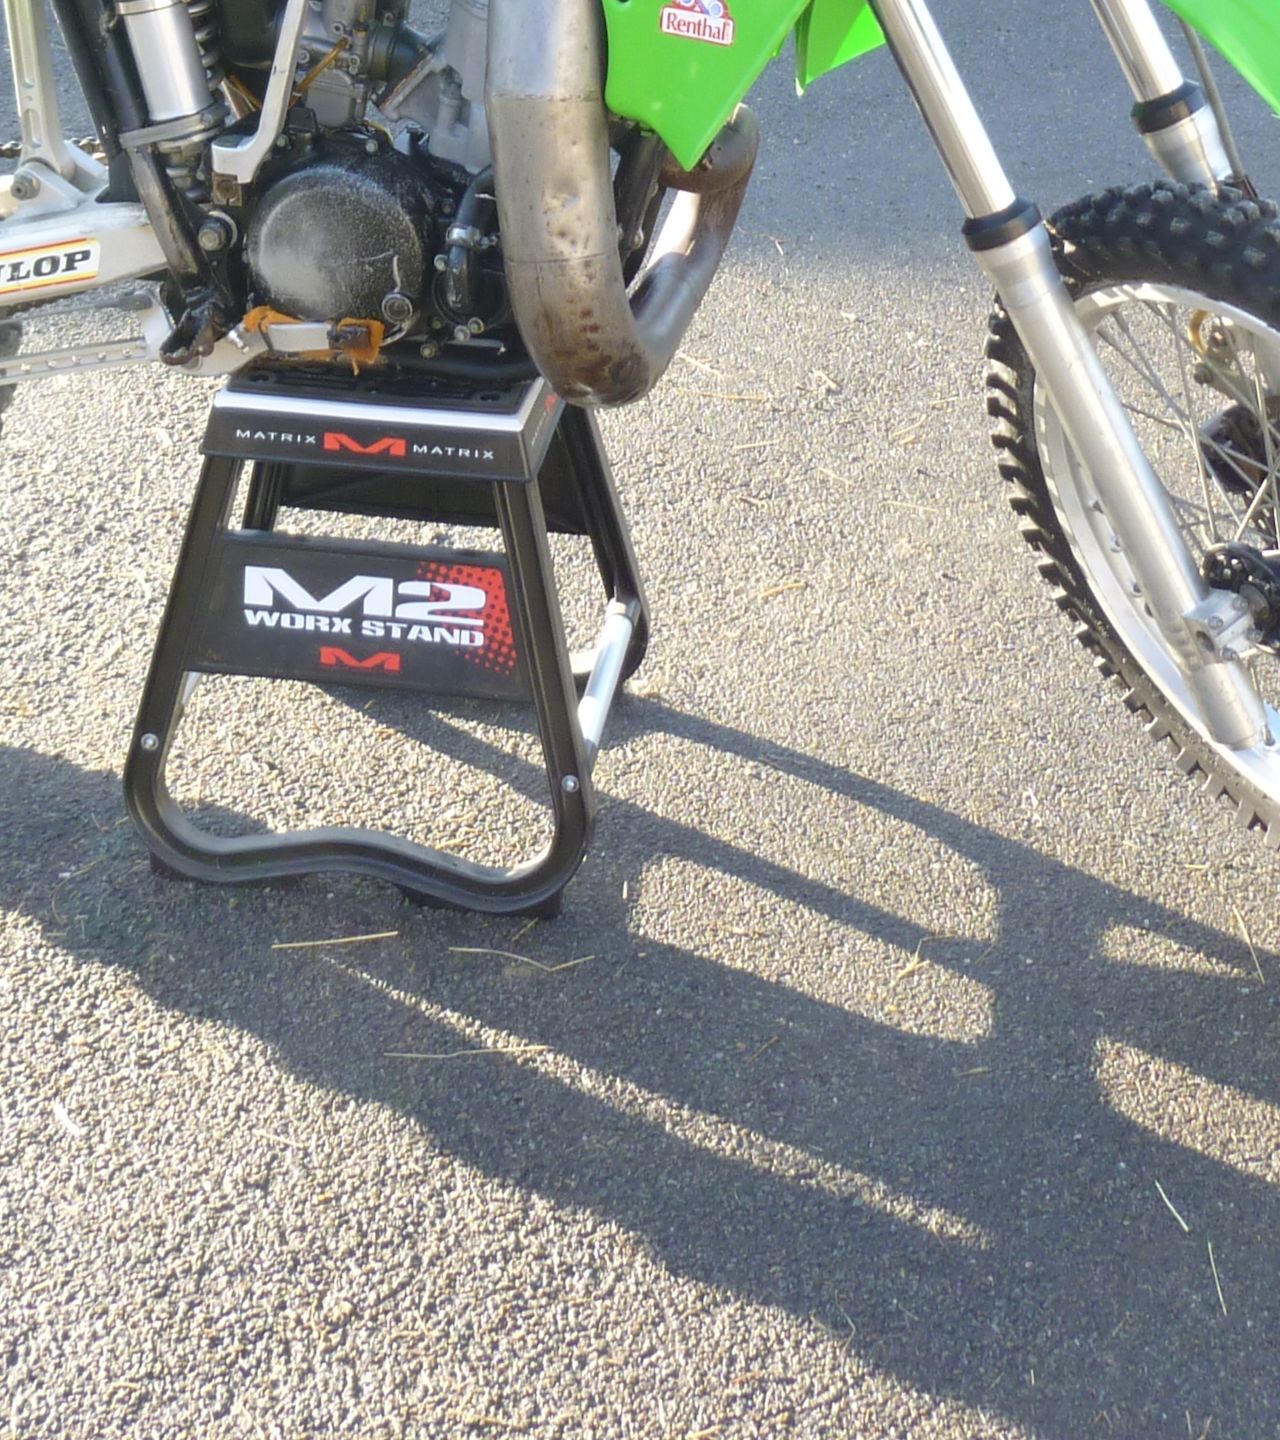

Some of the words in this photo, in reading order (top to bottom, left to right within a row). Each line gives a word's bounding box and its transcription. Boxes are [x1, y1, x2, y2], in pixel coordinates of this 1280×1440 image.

[666, 12, 726, 41] Renthal
[235, 428, 316, 445] MATRIX
[413, 443, 495, 460] MATRIX
[244, 565, 486, 626] M2
[244, 609, 353, 635] WORX
[361, 619, 484, 647] STAND
